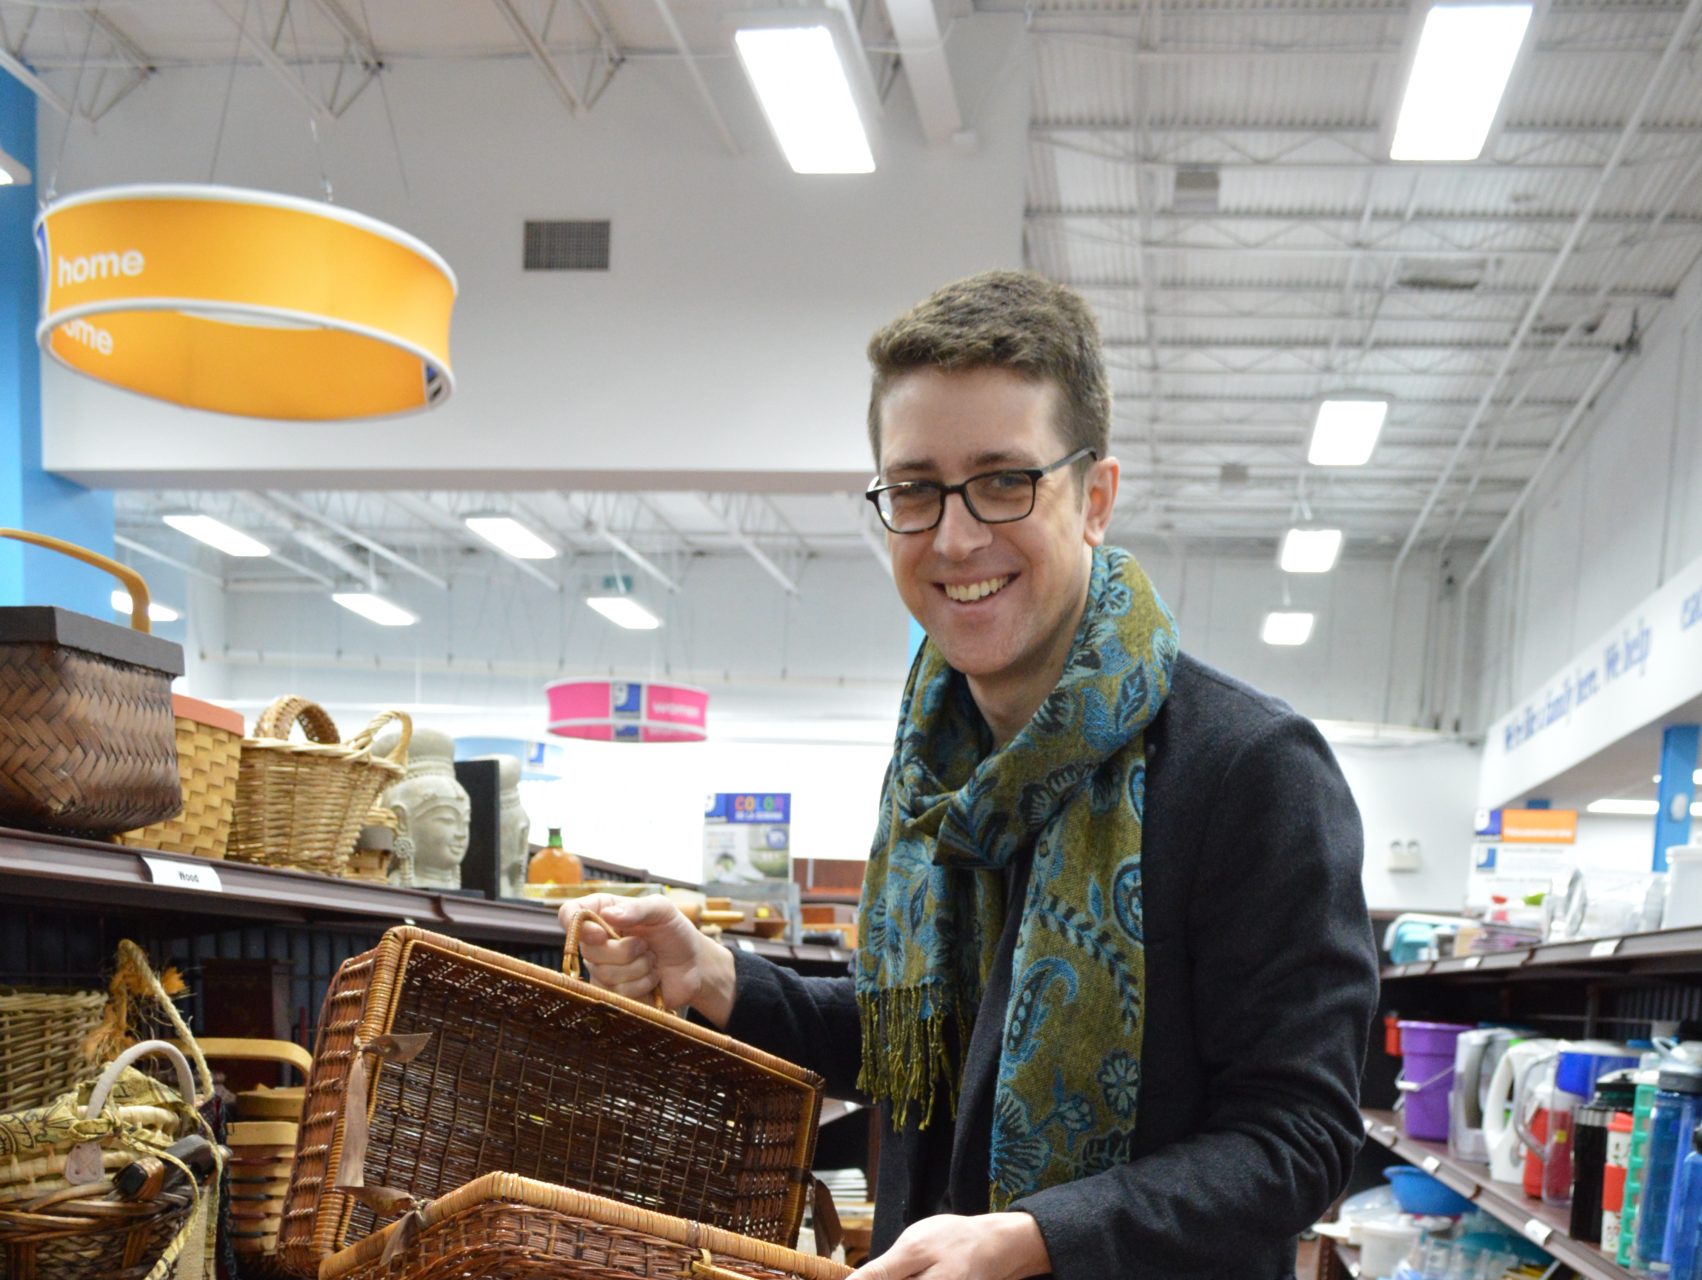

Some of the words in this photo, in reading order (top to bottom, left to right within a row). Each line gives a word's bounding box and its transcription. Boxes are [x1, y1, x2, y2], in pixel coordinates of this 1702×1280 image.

[58, 249, 144, 288] home
[63, 319, 113, 355] ome
[735, 795, 784, 812] COLOR
[178, 871, 199, 883] Wood
